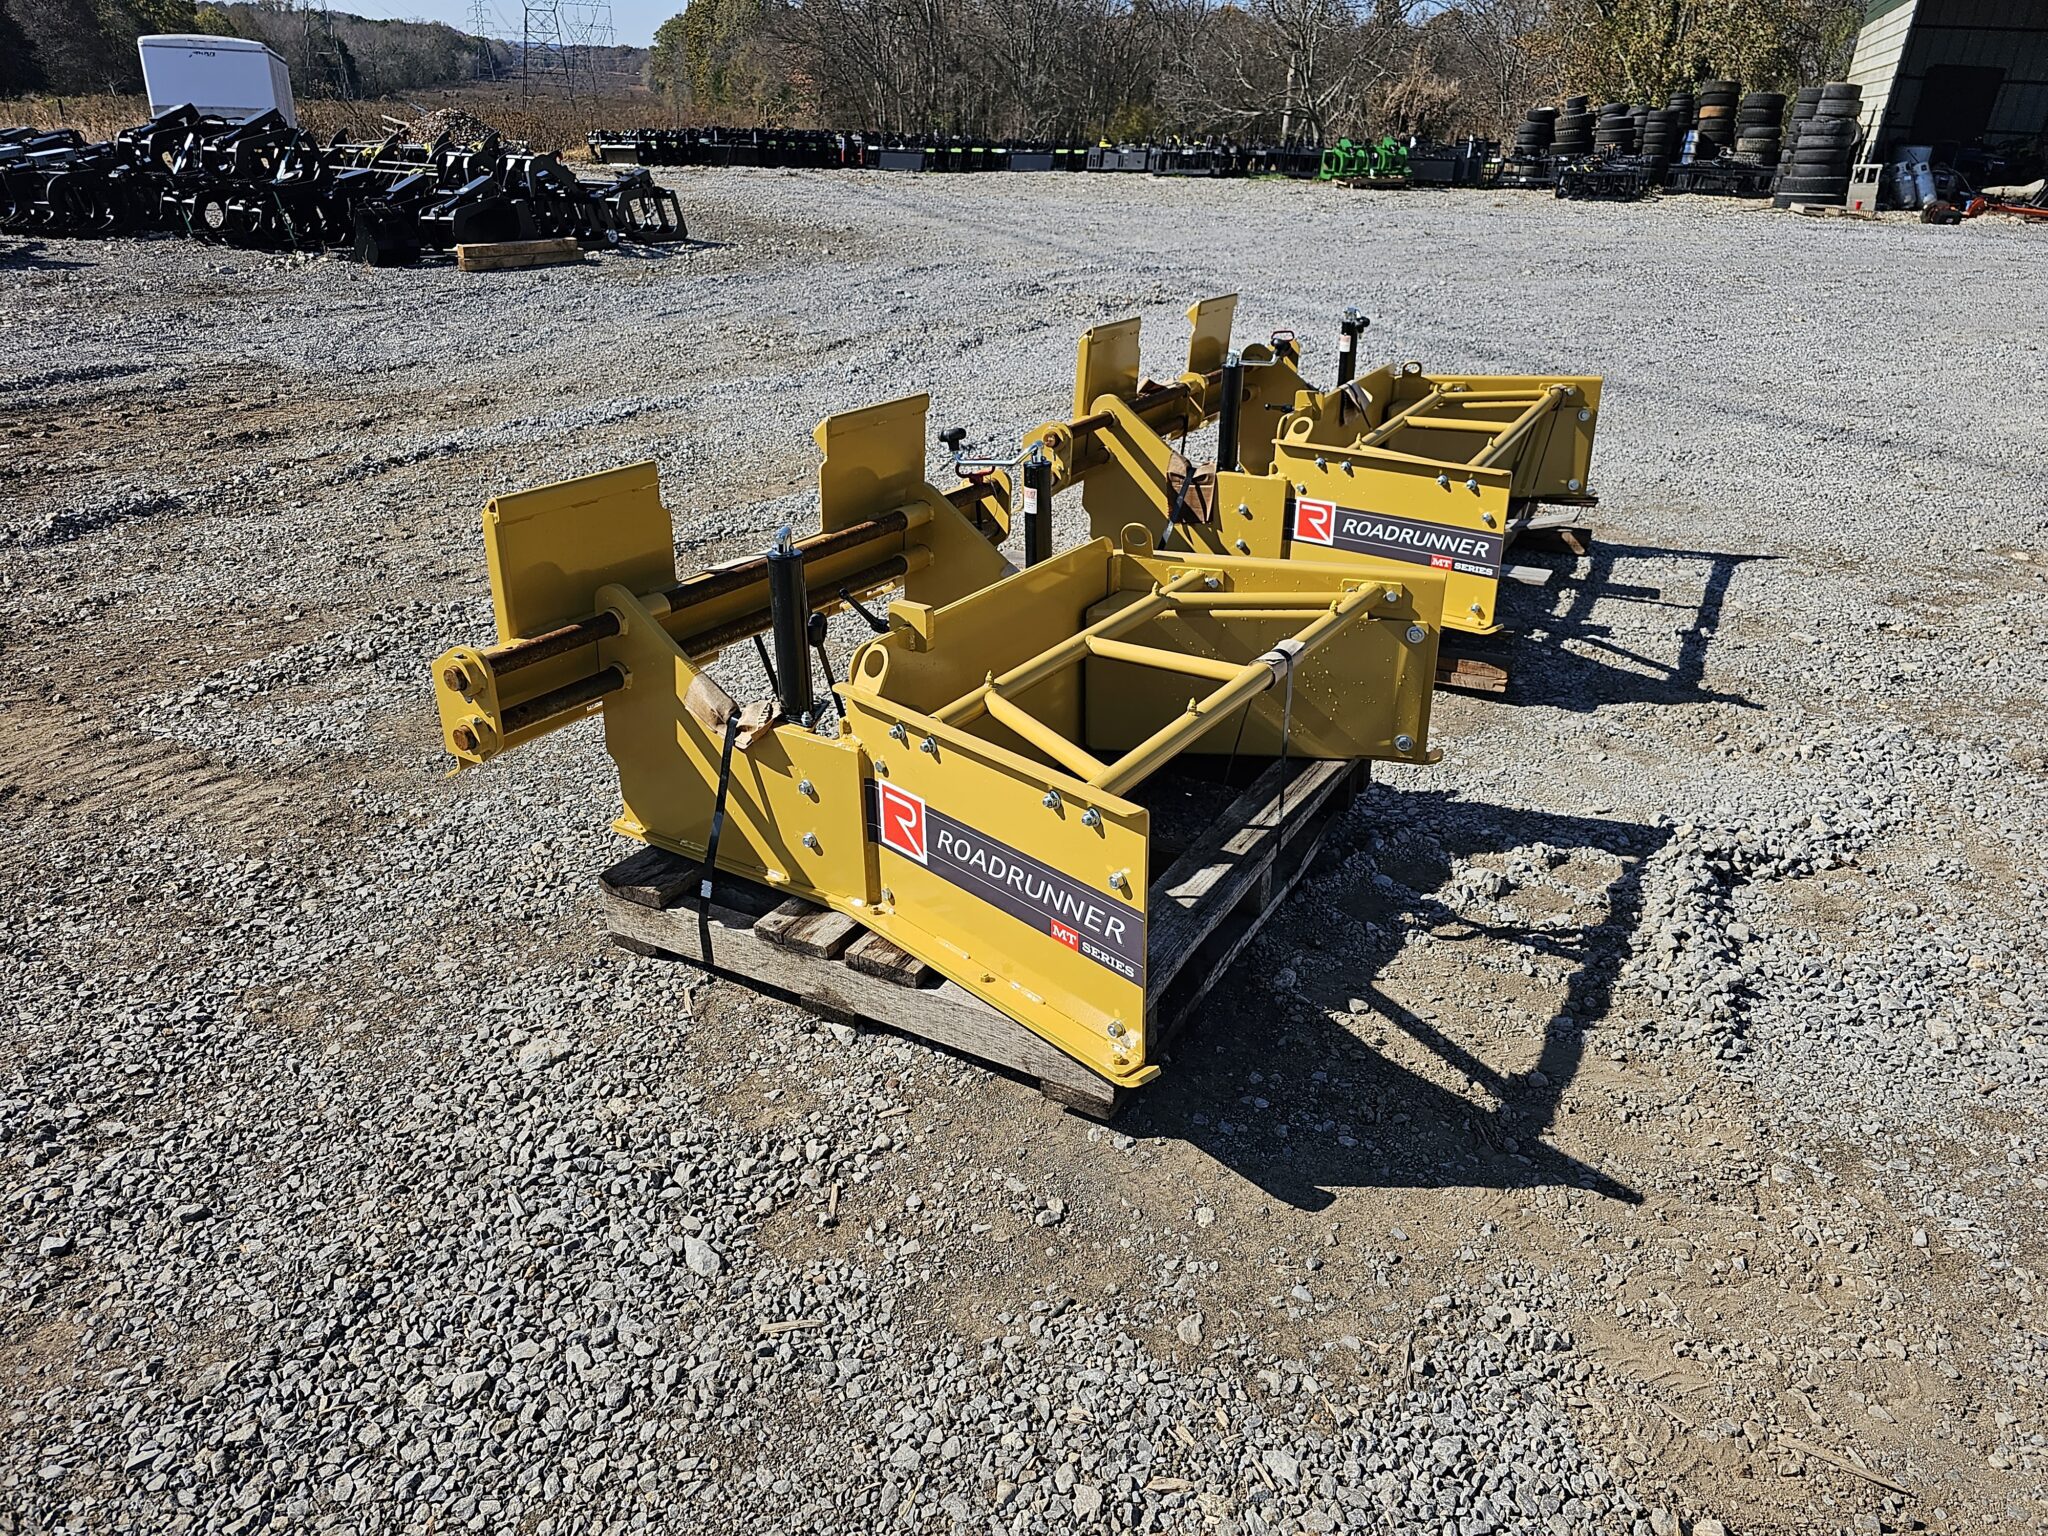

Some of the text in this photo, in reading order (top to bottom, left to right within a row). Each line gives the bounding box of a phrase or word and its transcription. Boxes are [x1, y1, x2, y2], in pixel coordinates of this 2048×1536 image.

[1300, 502, 1332, 544] R
[1342, 518, 1490, 558] ROADRUNNER
[1431, 557, 1494, 576] MT SERIES
[884, 790, 927, 864] R
[937, 829, 1126, 945] ROADRUNNER
[1052, 923, 1135, 978] MT SERIES
